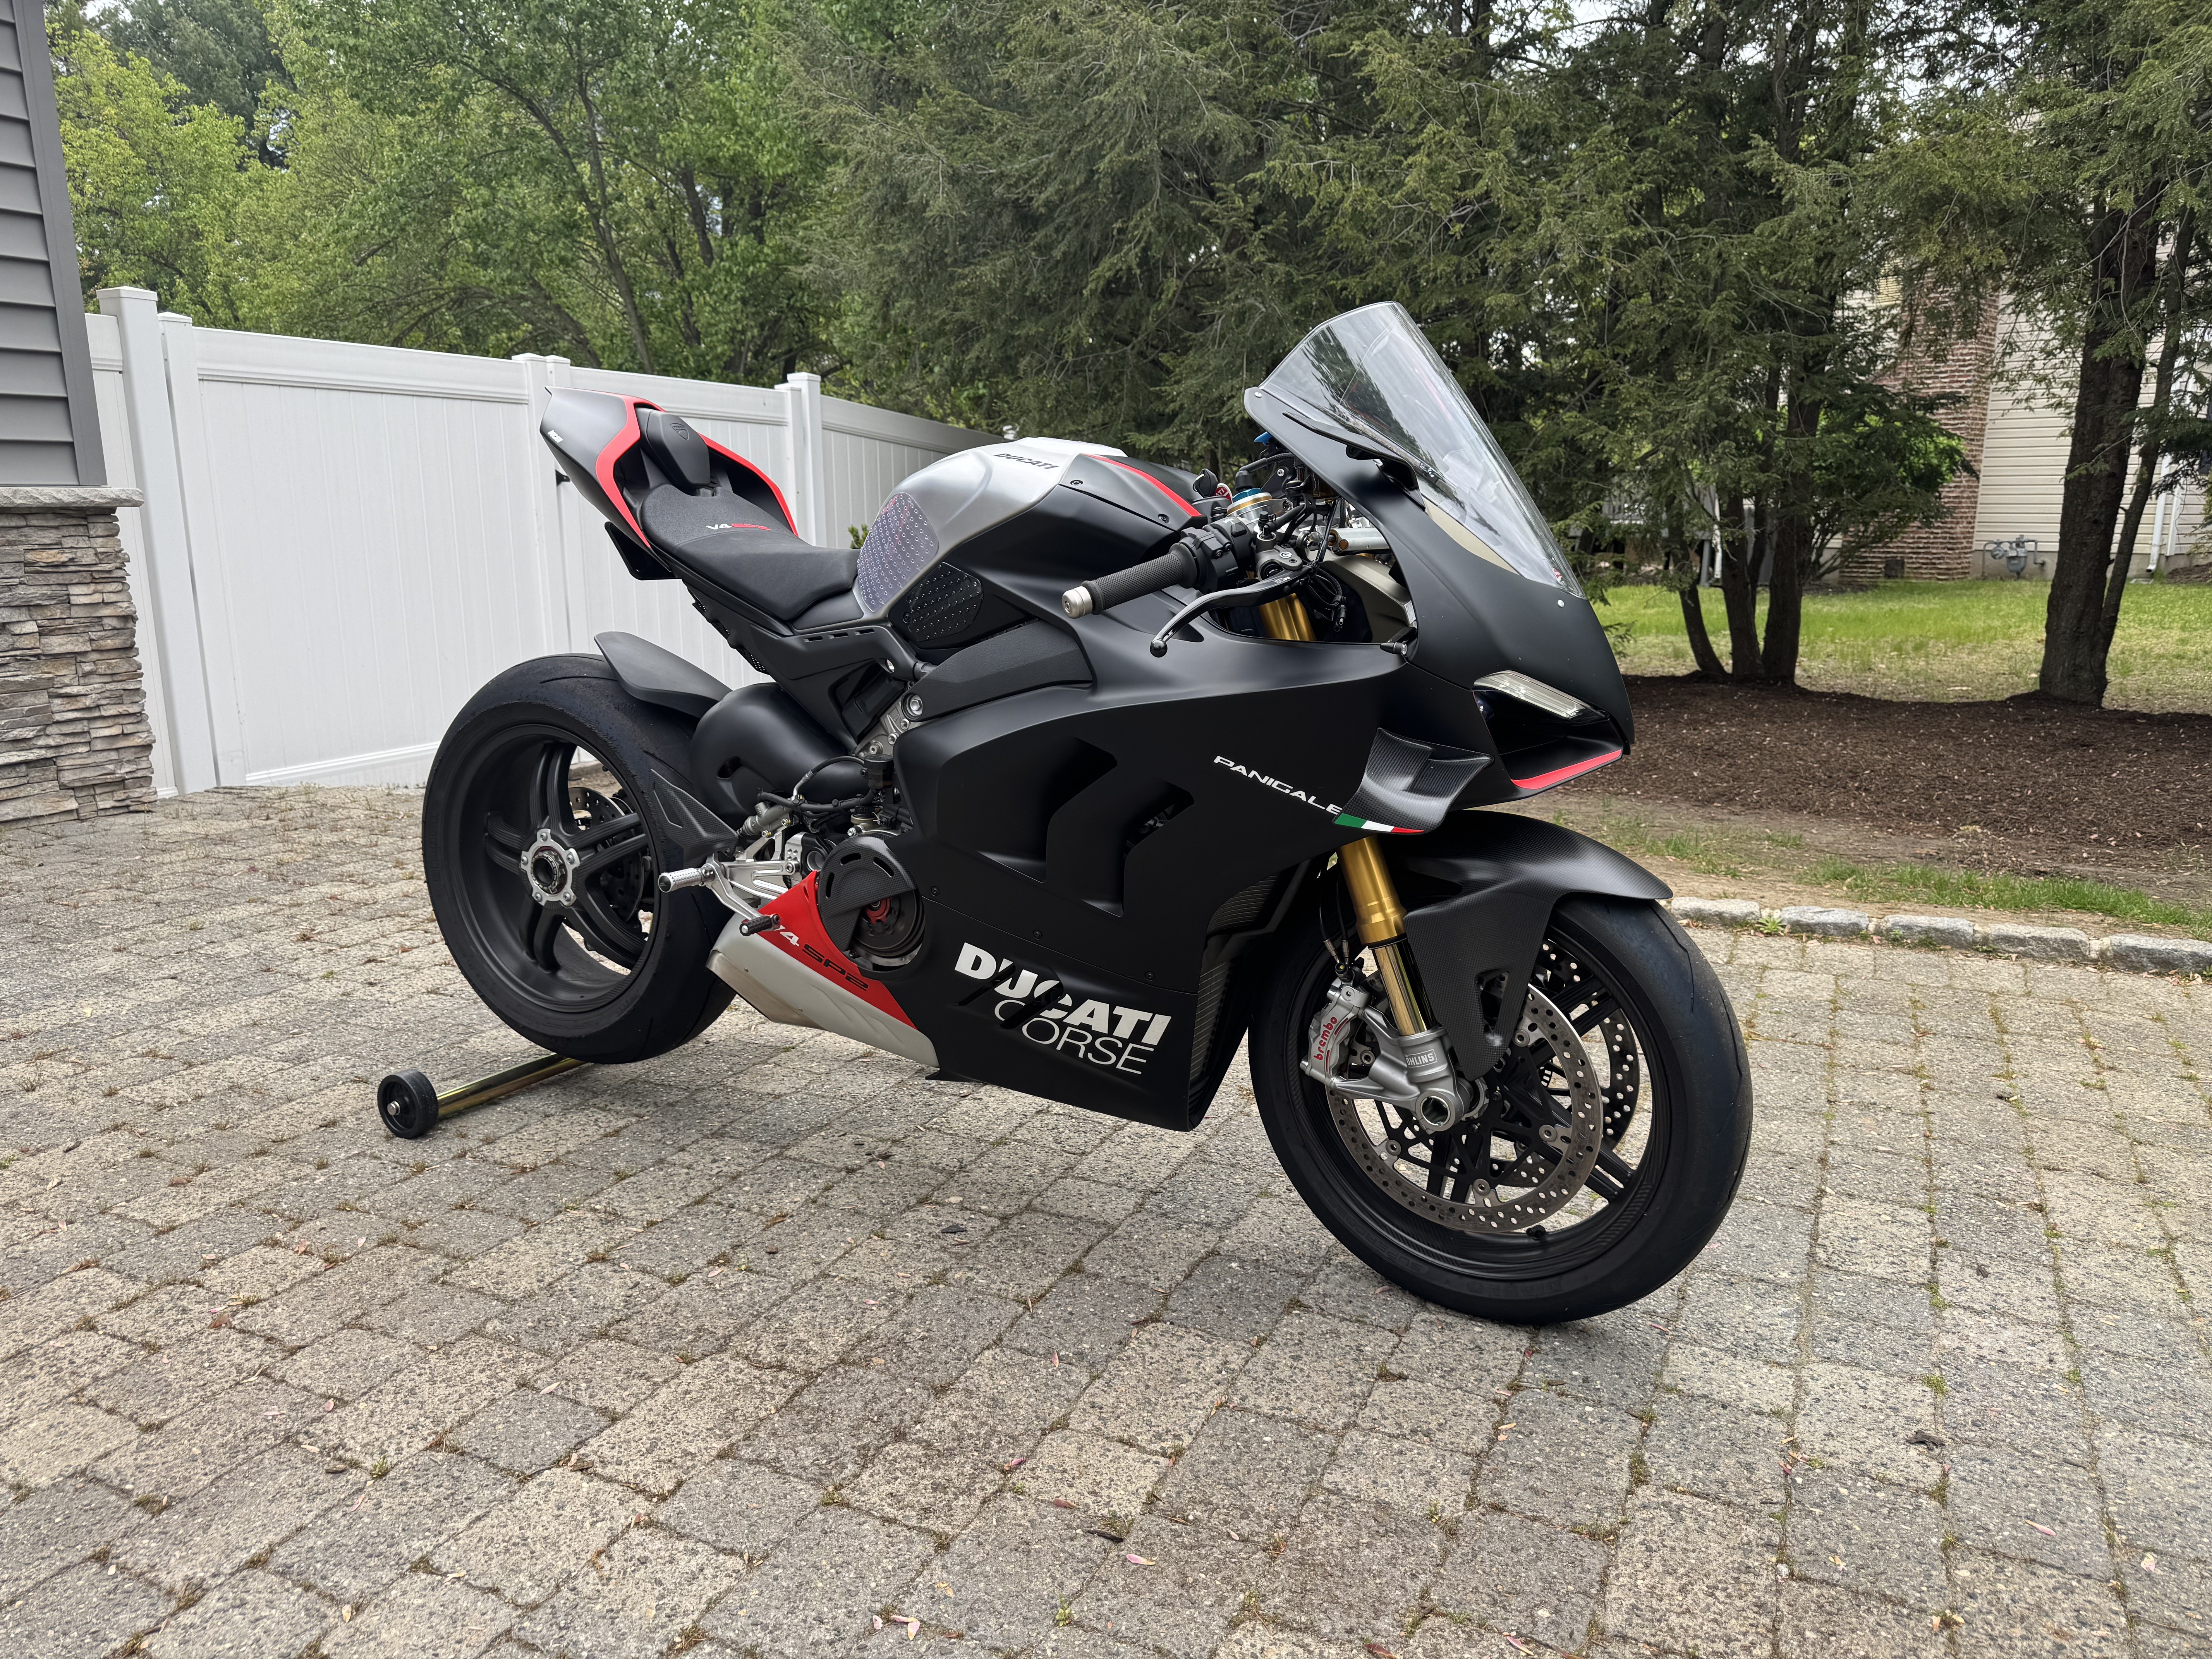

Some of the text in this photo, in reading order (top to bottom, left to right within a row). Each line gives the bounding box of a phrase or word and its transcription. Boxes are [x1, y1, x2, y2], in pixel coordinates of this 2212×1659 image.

[993, 453, 1060, 469] DUCATI
[1213, 756, 1343, 815] PANIGALE
[802, 943, 869, 991] SP2
[954, 942, 1172, 1046] DUCATI
[994, 999, 1154, 1075] CORSE
[1314, 1017, 1338, 1061] brembo
[1405, 1053, 1434, 1066] ÖHLINS
